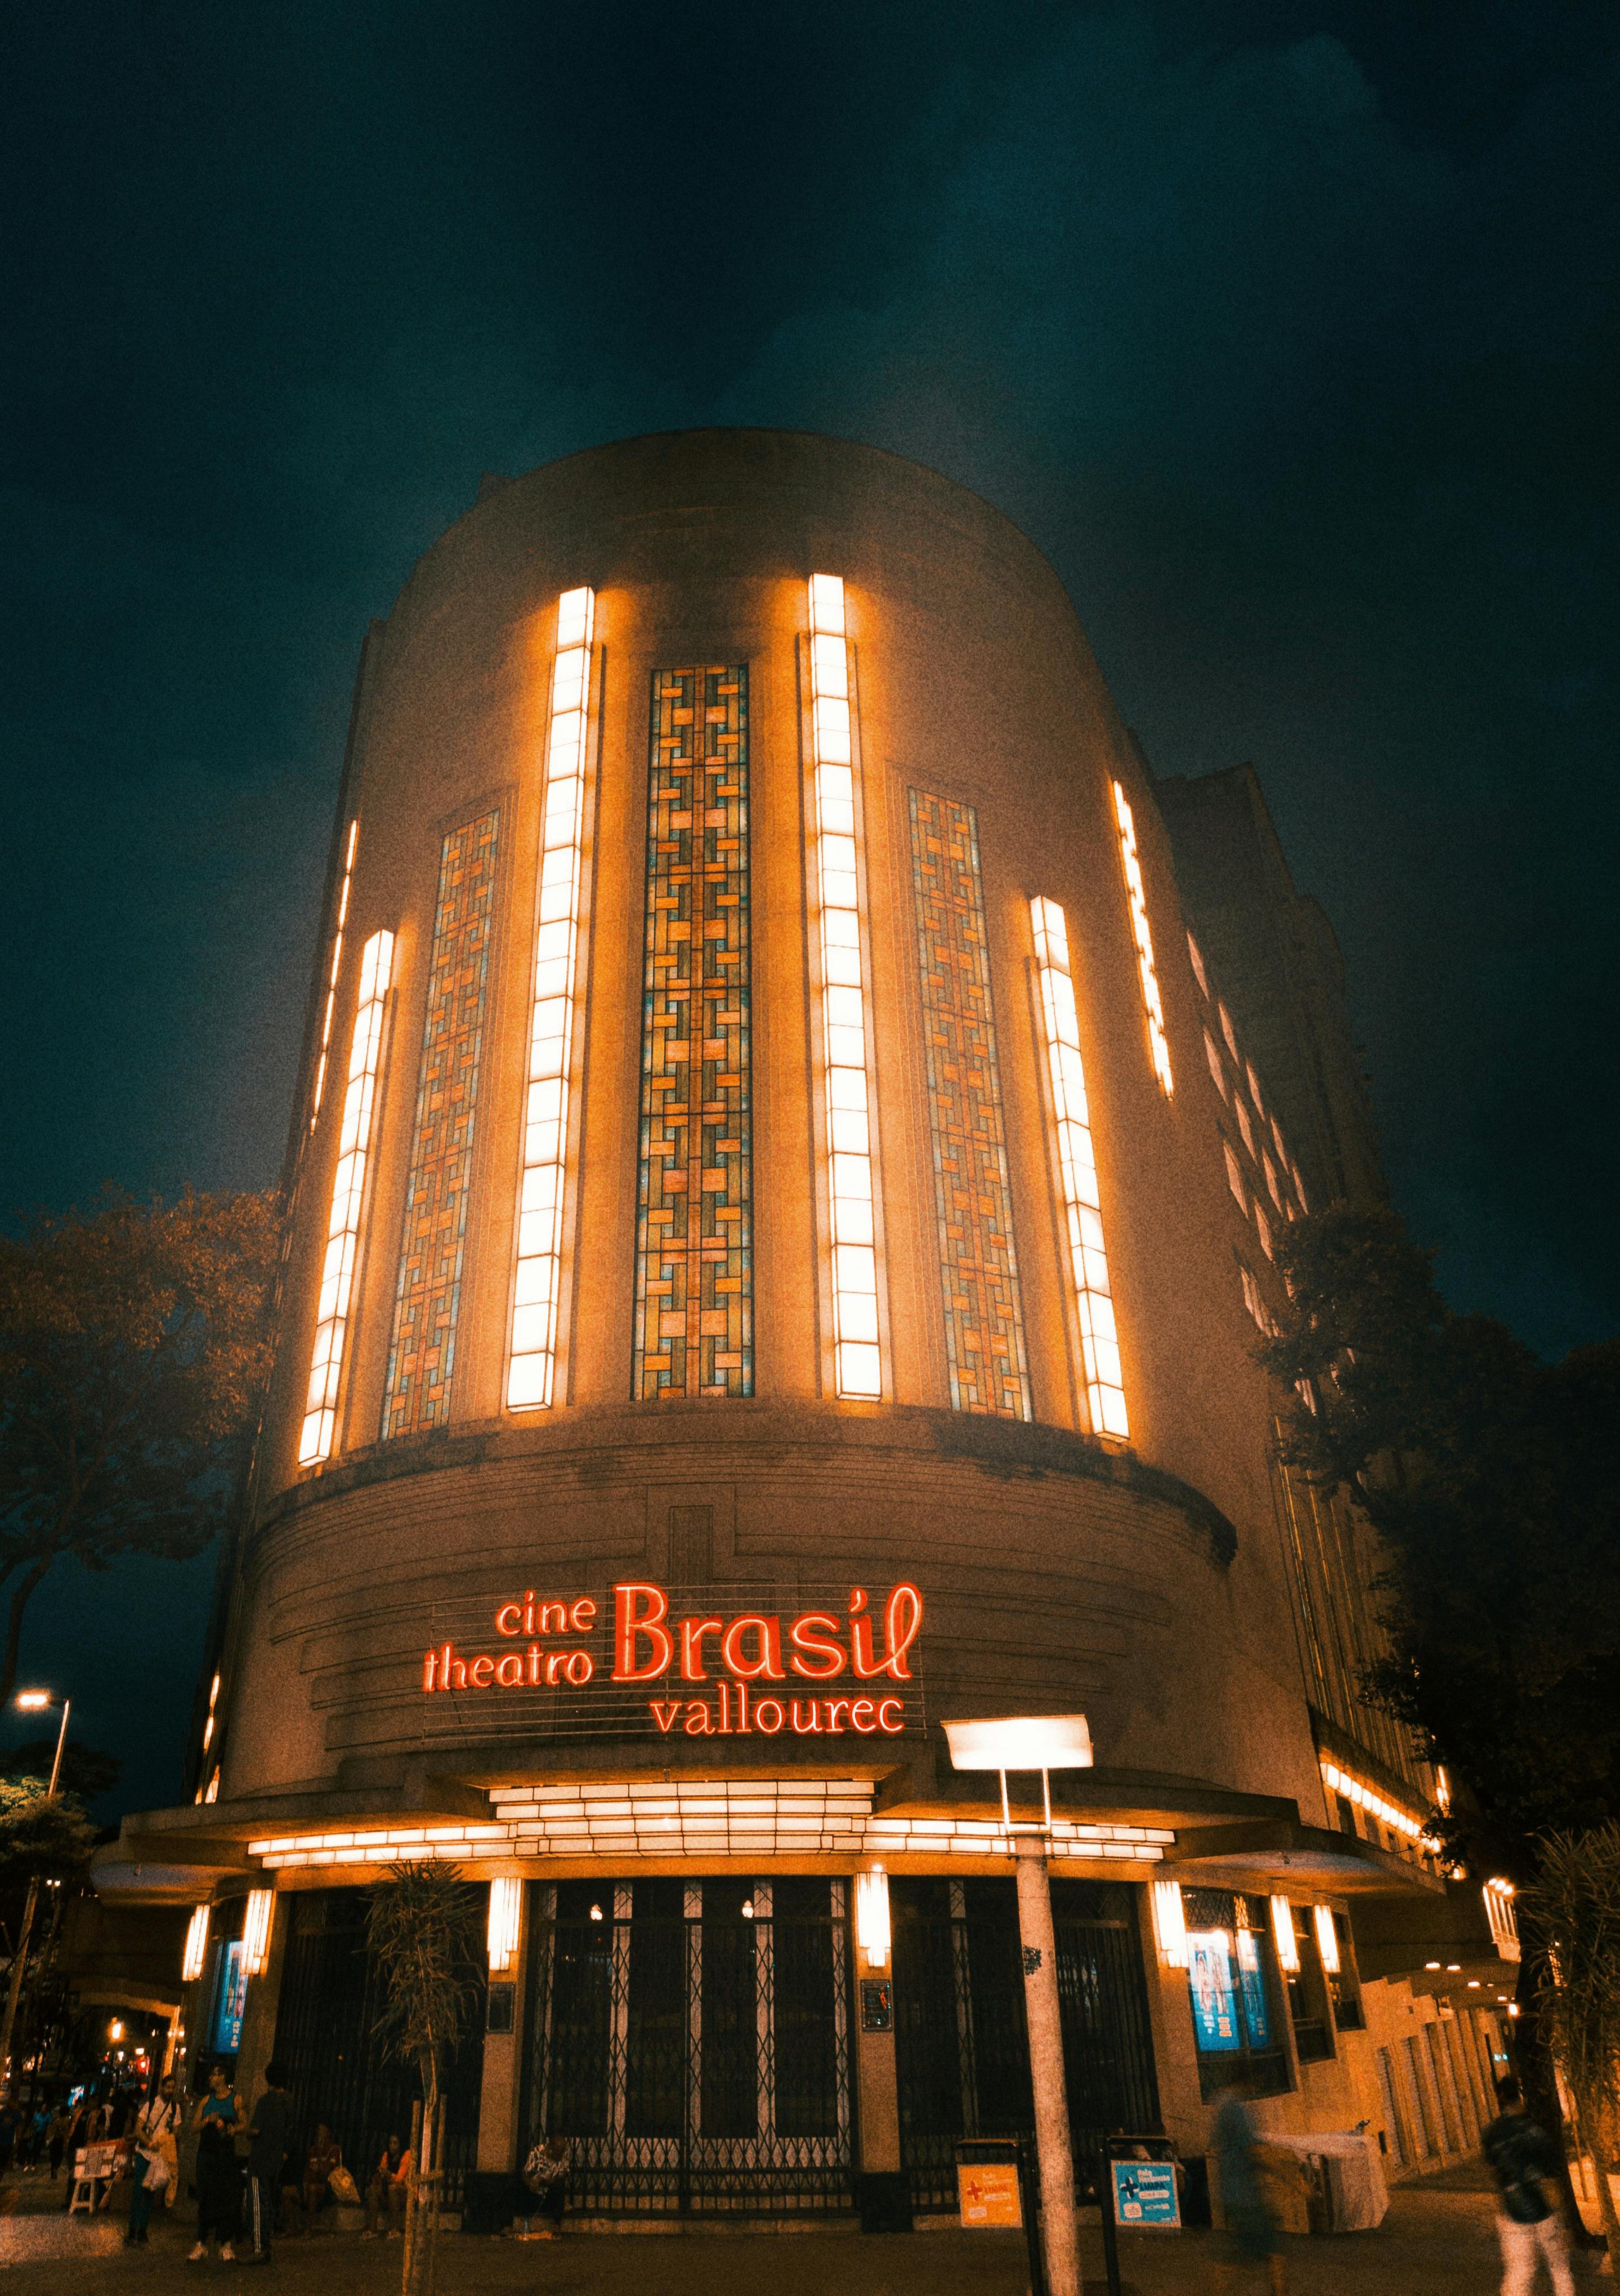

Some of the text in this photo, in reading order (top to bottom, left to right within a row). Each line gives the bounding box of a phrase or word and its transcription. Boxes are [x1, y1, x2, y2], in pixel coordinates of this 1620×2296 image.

[495, 1589, 598, 1637] cine
[610, 1581, 923, 1681] Brasil
[423, 1640, 595, 1693] theatro
[649, 1681, 905, 1735] vallourec
